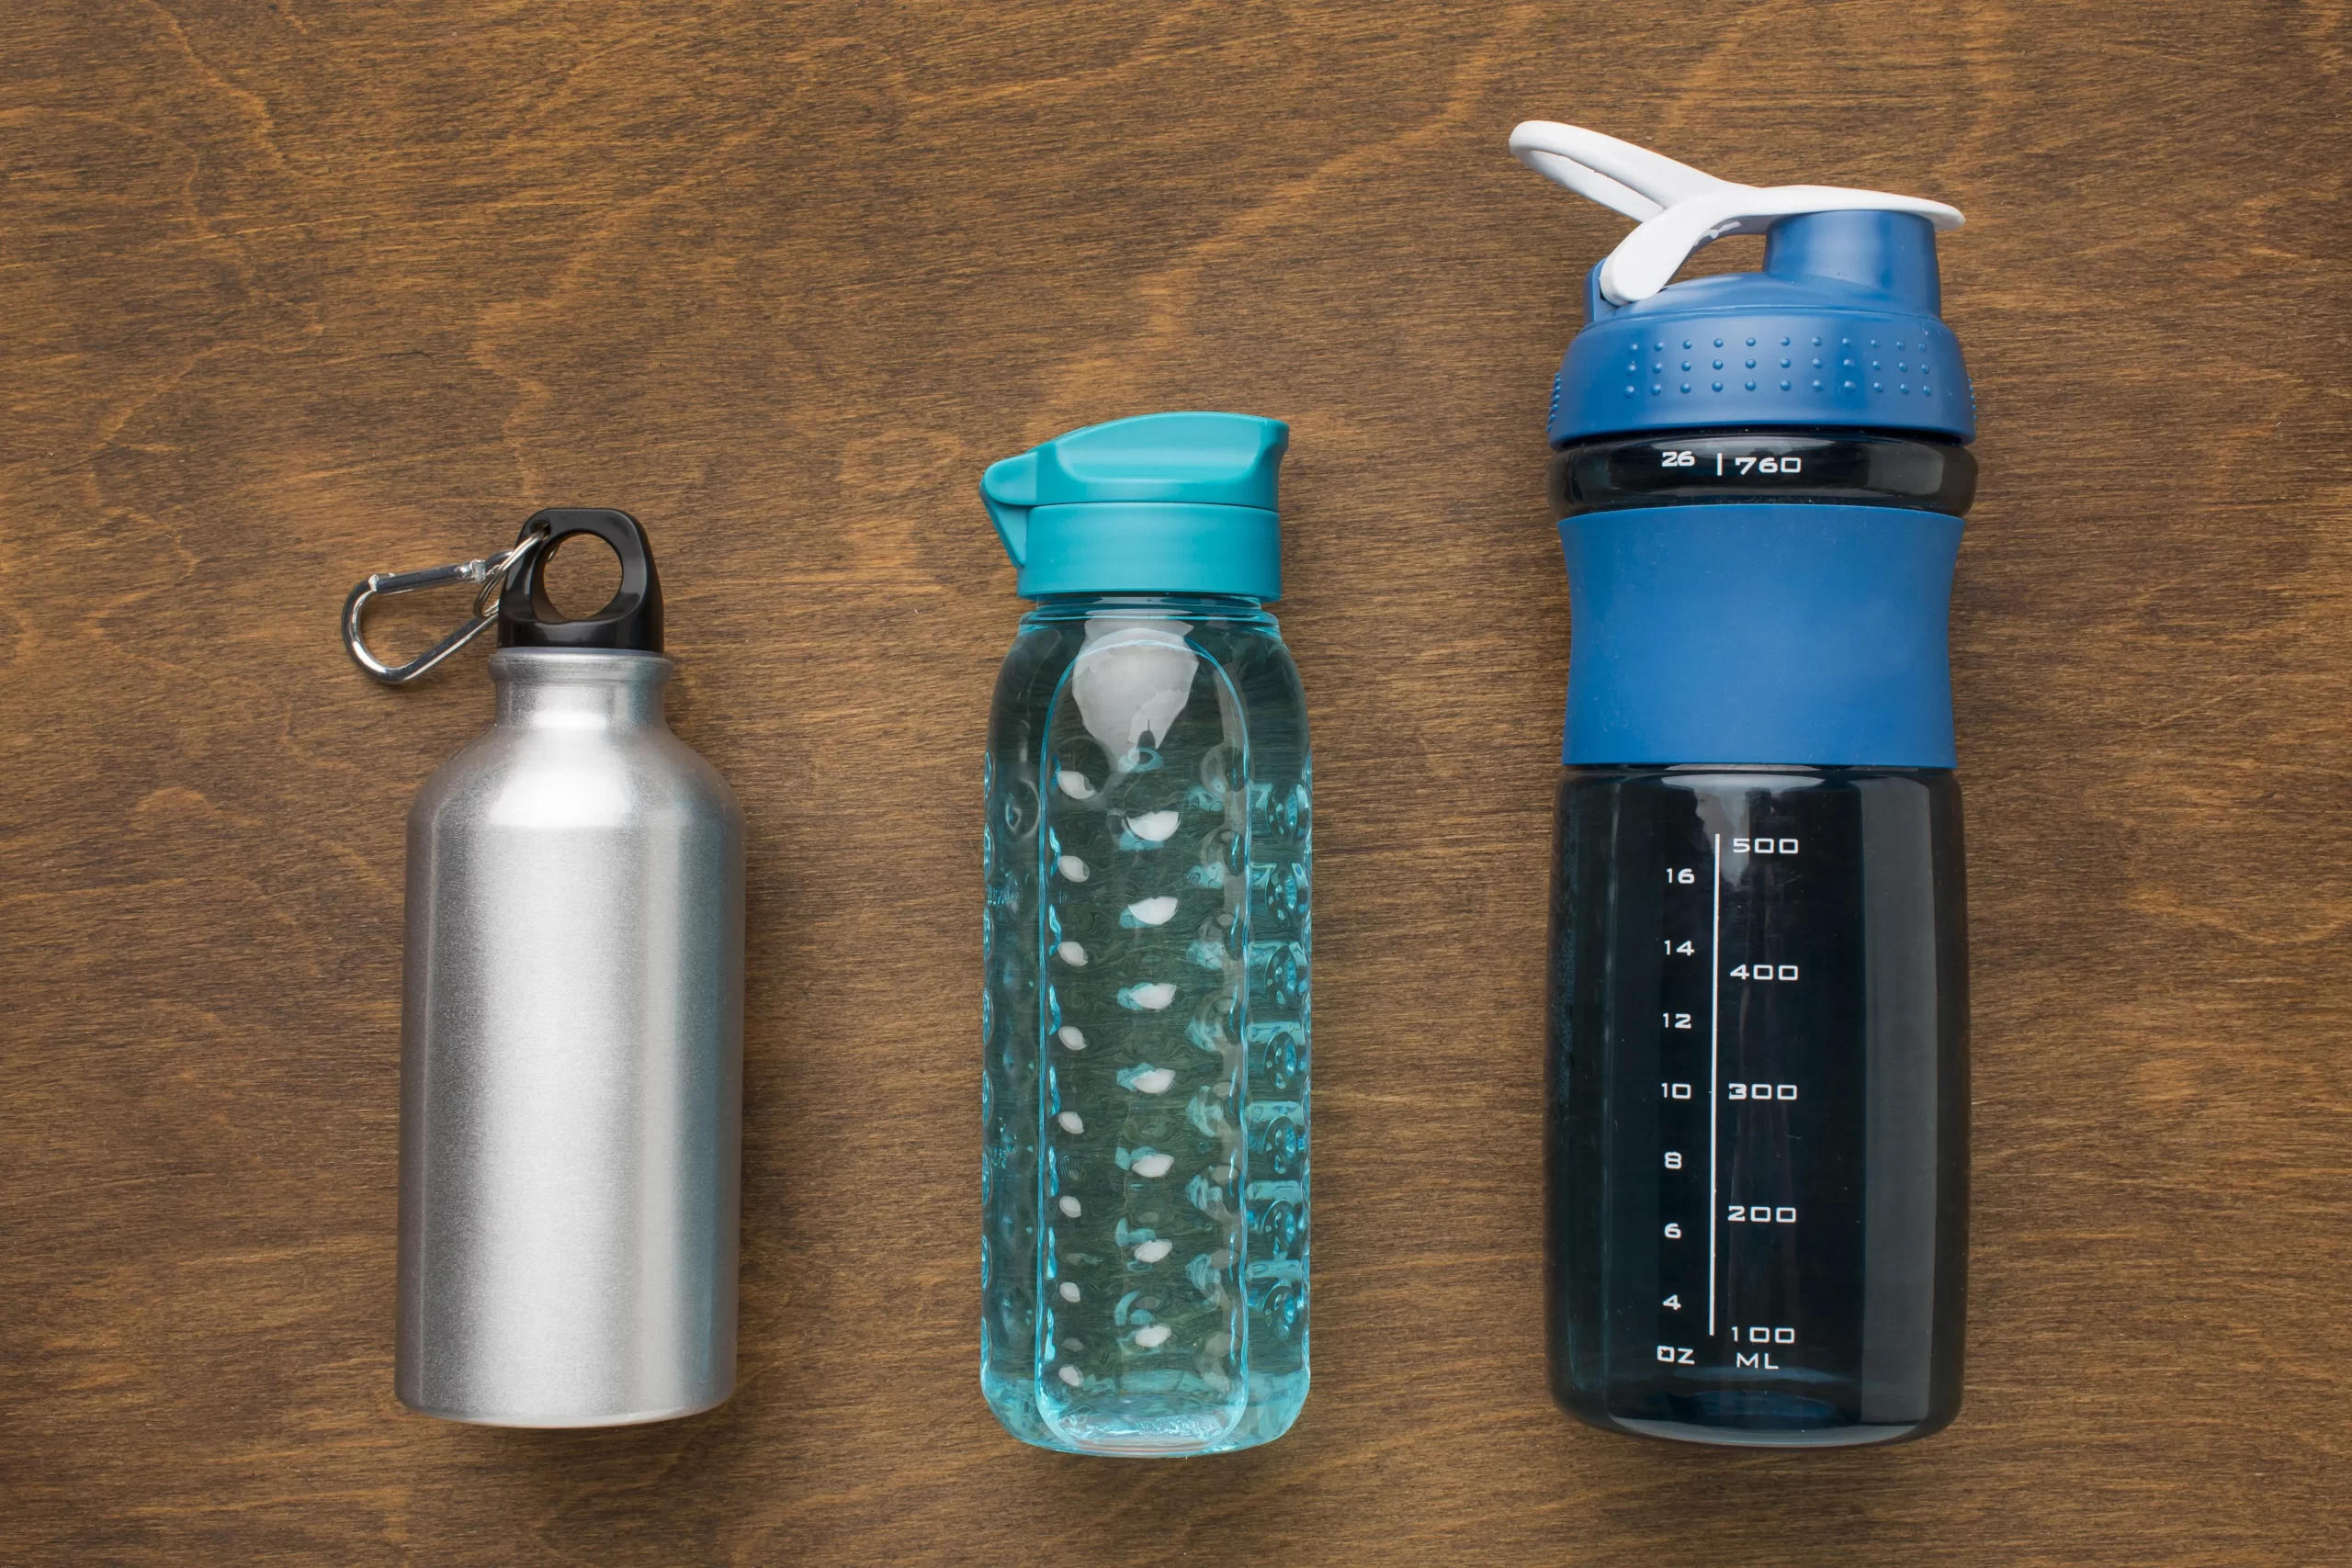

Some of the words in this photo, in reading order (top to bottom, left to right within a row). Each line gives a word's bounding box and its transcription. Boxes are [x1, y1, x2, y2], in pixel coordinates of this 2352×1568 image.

[1661, 450, 1695, 468] 26
[1735, 457, 1802, 476] 760
[1733, 838, 1799, 854] 500
[1666, 867, 1695, 885] 16
[1664, 940, 1695, 956] 14
[1729, 964, 1799, 981] 400
[1662, 1012, 1691, 1029] 12
[1661, 1082, 1691, 1100] 10
[1728, 1083, 1798, 1100] 300
[1664, 1151, 1682, 1169] 8
[1727, 1205, 1797, 1224] 200
[1664, 1223, 1681, 1239] 6
[1662, 1294, 1681, 1311] 4
[1731, 1325, 1795, 1344] 100
[1657, 1345, 1695, 1365] OZ
[1736, 1352, 1780, 1371] ML
